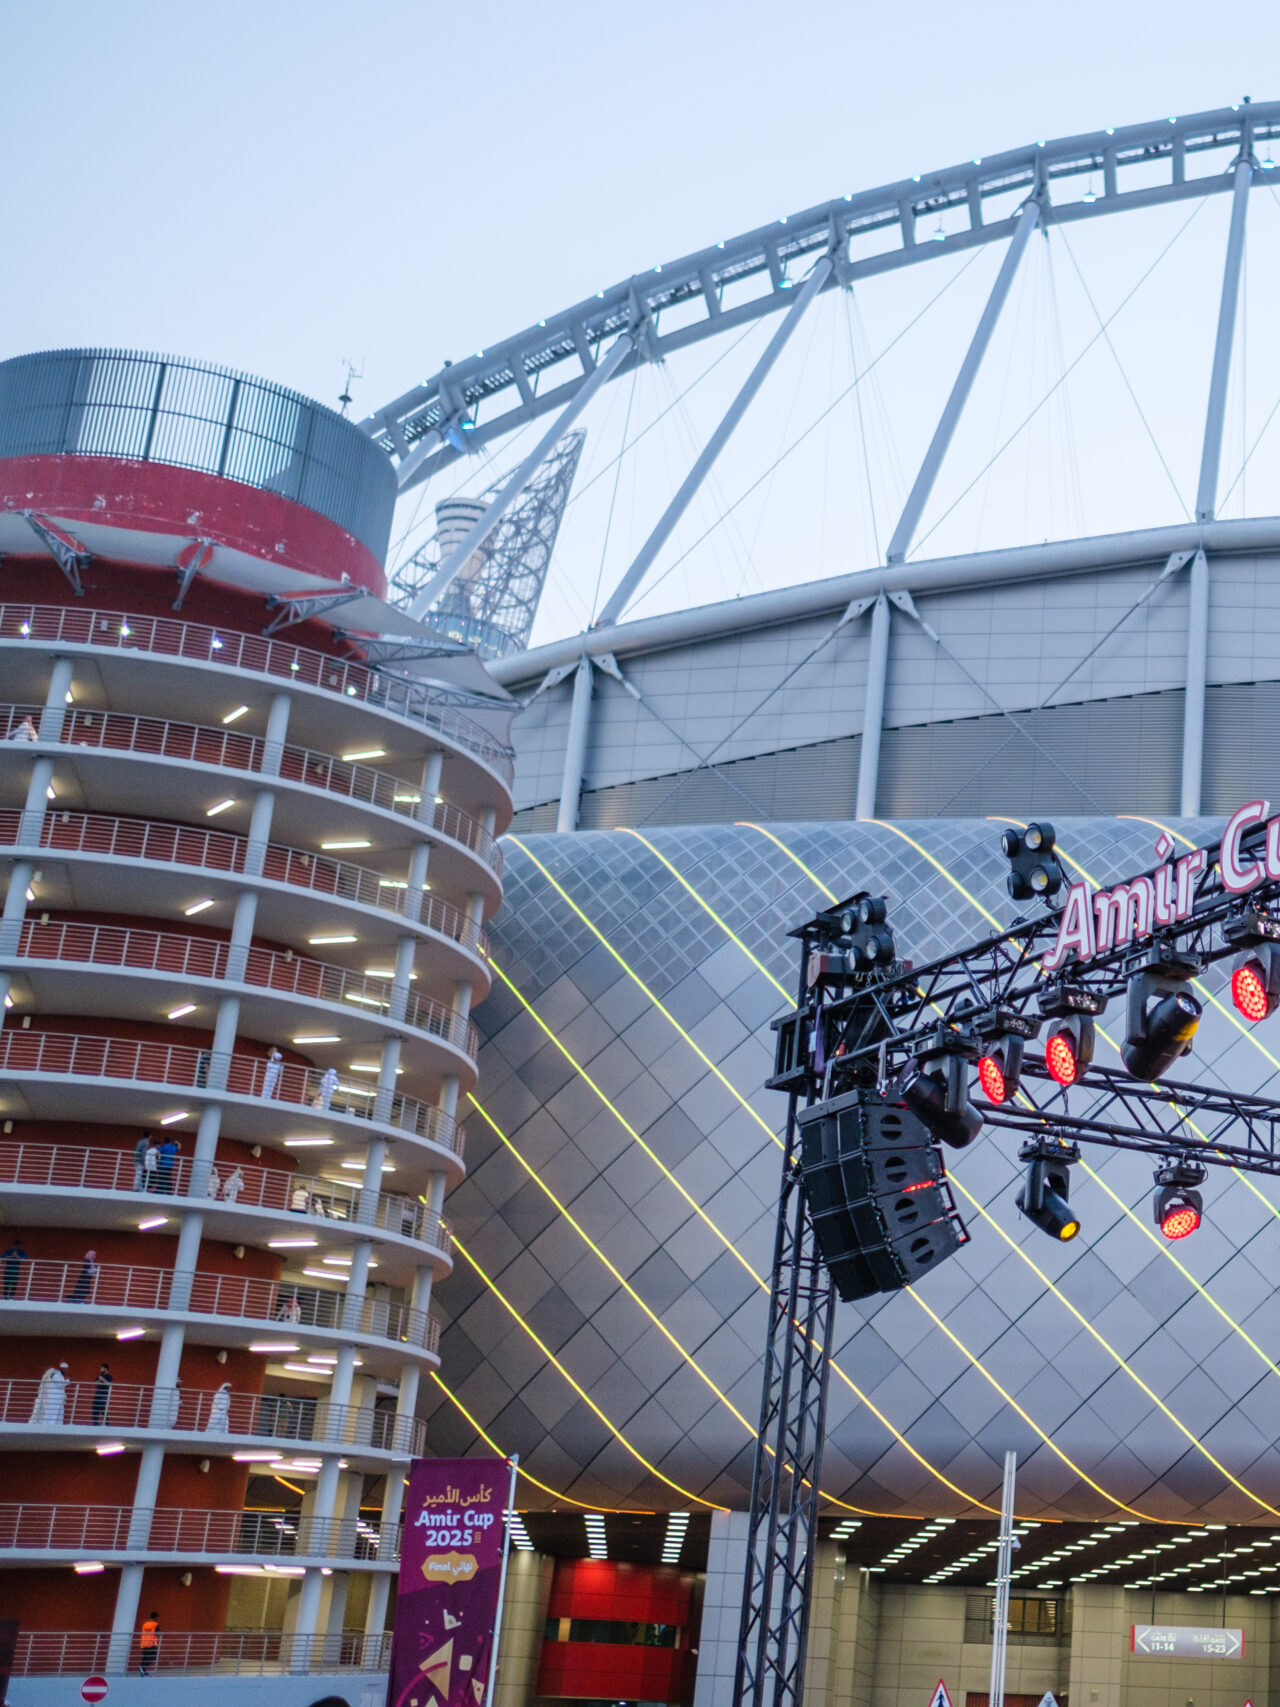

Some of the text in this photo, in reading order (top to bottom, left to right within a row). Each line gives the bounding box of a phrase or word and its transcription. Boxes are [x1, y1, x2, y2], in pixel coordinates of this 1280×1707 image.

[1042, 832, 1208, 972] Amir
[423, 1484, 492, 1507] كأس الأمير
[414, 1509, 494, 1529] Amir Cup
[425, 1529, 472, 1547] 2025
[428, 1561, 451, 1571] Final
[1151, 1642, 1175, 1651] 11-14
[1203, 1644, 1226, 1653] 15-23
